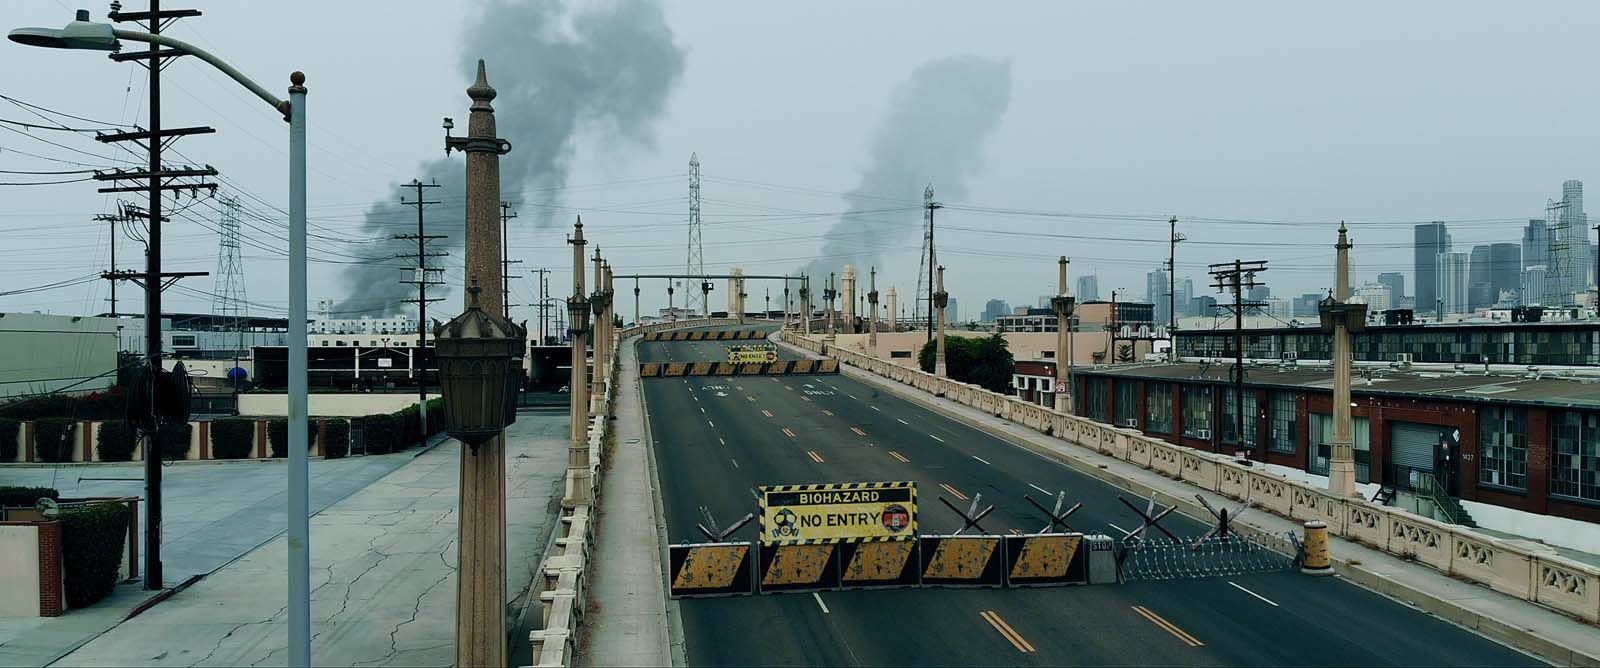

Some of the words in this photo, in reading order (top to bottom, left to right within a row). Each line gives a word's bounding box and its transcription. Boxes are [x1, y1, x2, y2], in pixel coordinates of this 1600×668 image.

[800, 491, 879, 504] BIOHAZARD
[800, 514, 822, 527] NO
[827, 512, 880, 526] ENTRY
[1092, 541, 1112, 550] STOP
